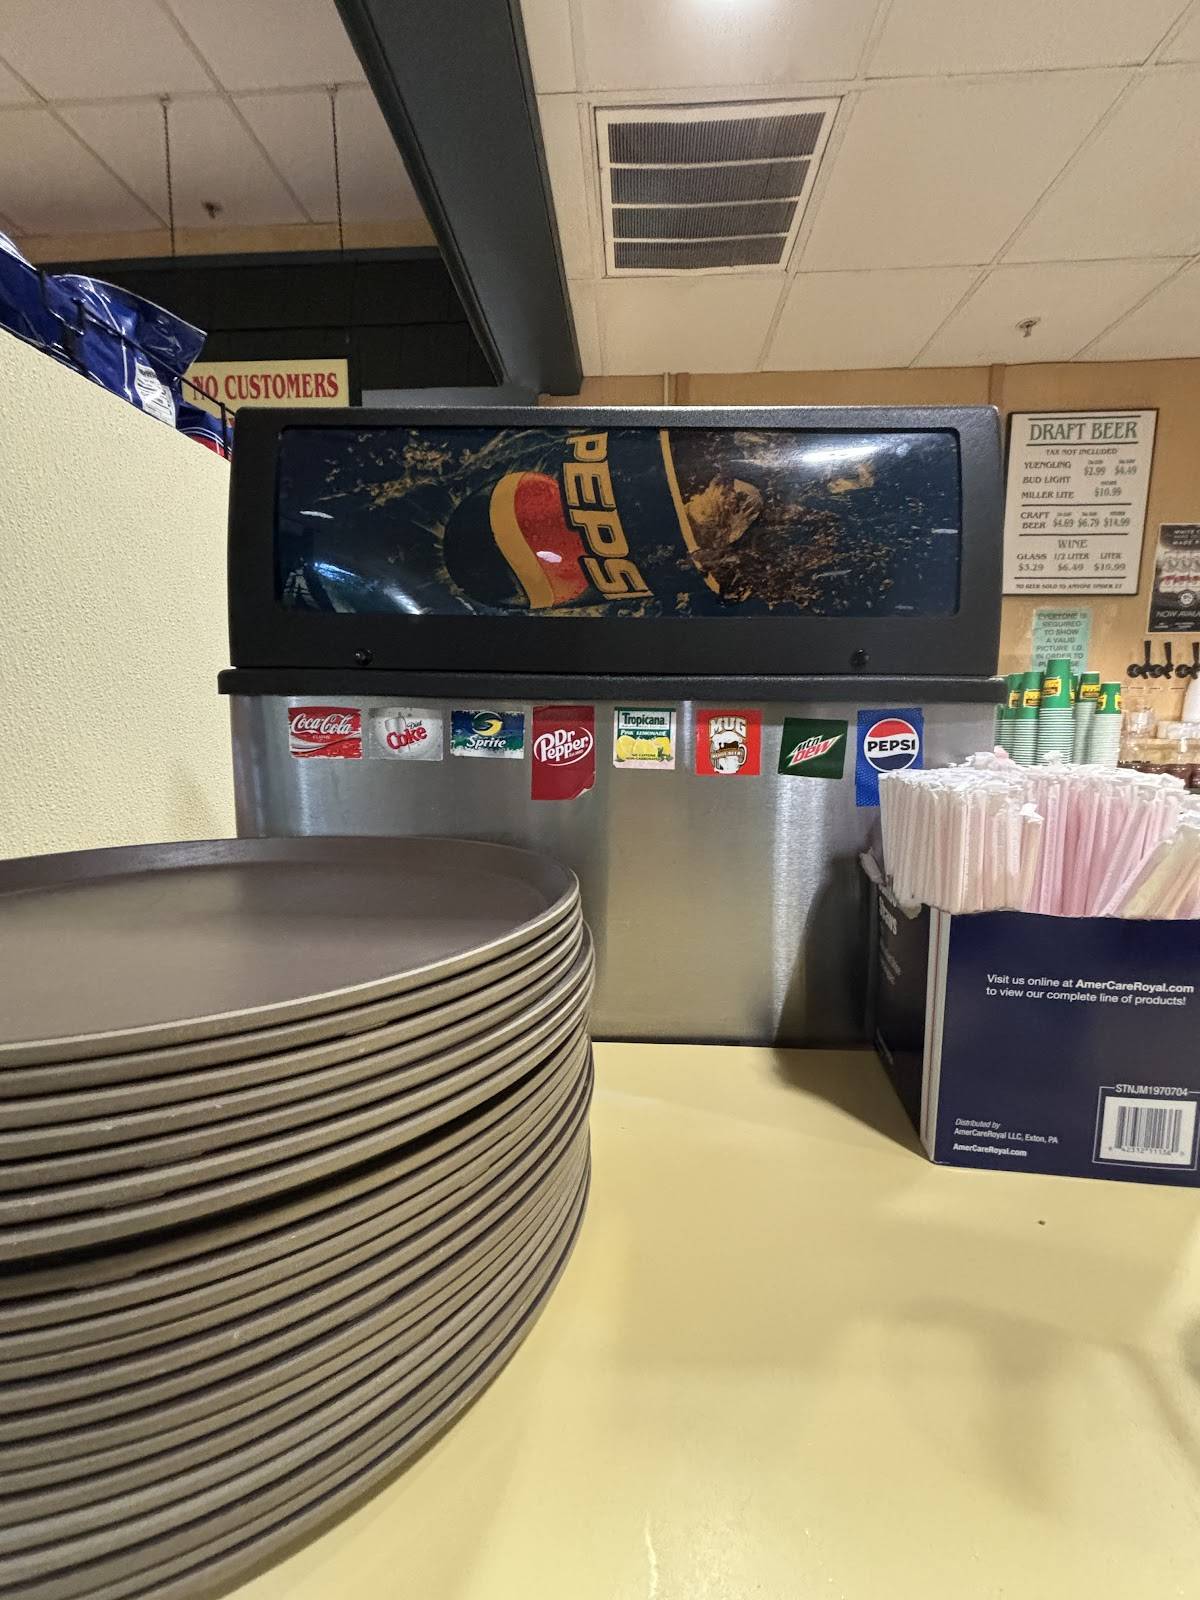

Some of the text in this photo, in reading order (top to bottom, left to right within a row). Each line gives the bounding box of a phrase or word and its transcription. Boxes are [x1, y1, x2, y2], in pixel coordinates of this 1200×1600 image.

[191, 374, 218, 400] NO
[225, 372, 339, 400] CUSTOMERS
[1030, 421, 1138, 441] DRAFT BEER
[1024, 461, 1071, 469] YUENGLING
[1084, 466, 1106, 476] $2.99
[1022, 476, 1071, 484] BUD LIGHT
[1021, 491, 1074, 499] MILLER LITE
[1094, 487, 1122, 497] $10.99
[563, 431, 655, 601] PEPSI
[1020, 511, 1050, 519] CRAFT
[1022, 521, 1046, 529] BEER
[1057, 539, 1088, 549] WINE
[1067, 552, 1090, 560] LITER
[621, 712, 666, 727] Tropicana
[710, 717, 747, 738] MUG
[386, 726, 428, 750] Coke
[465, 734, 507, 749] Sprite
[554, 729, 576, 746] Dr
[540, 734, 589, 763] Pepper
[867, 739, 916, 752] PEPSI
[987, 974, 1194, 993] Visit us online at AmerCareRoyal.com
[986, 987, 1186, 1006] to view our complete line of products!
[1115, 1084, 1188, 1096] STNJM1970704
[955, 1118, 1001, 1129] Distributed by
[954, 1128, 1059, 1144] AmerCareRoyal LLC, Exton, PA
[953, 1143, 1027, 1157] AmerCareRoyal.com
